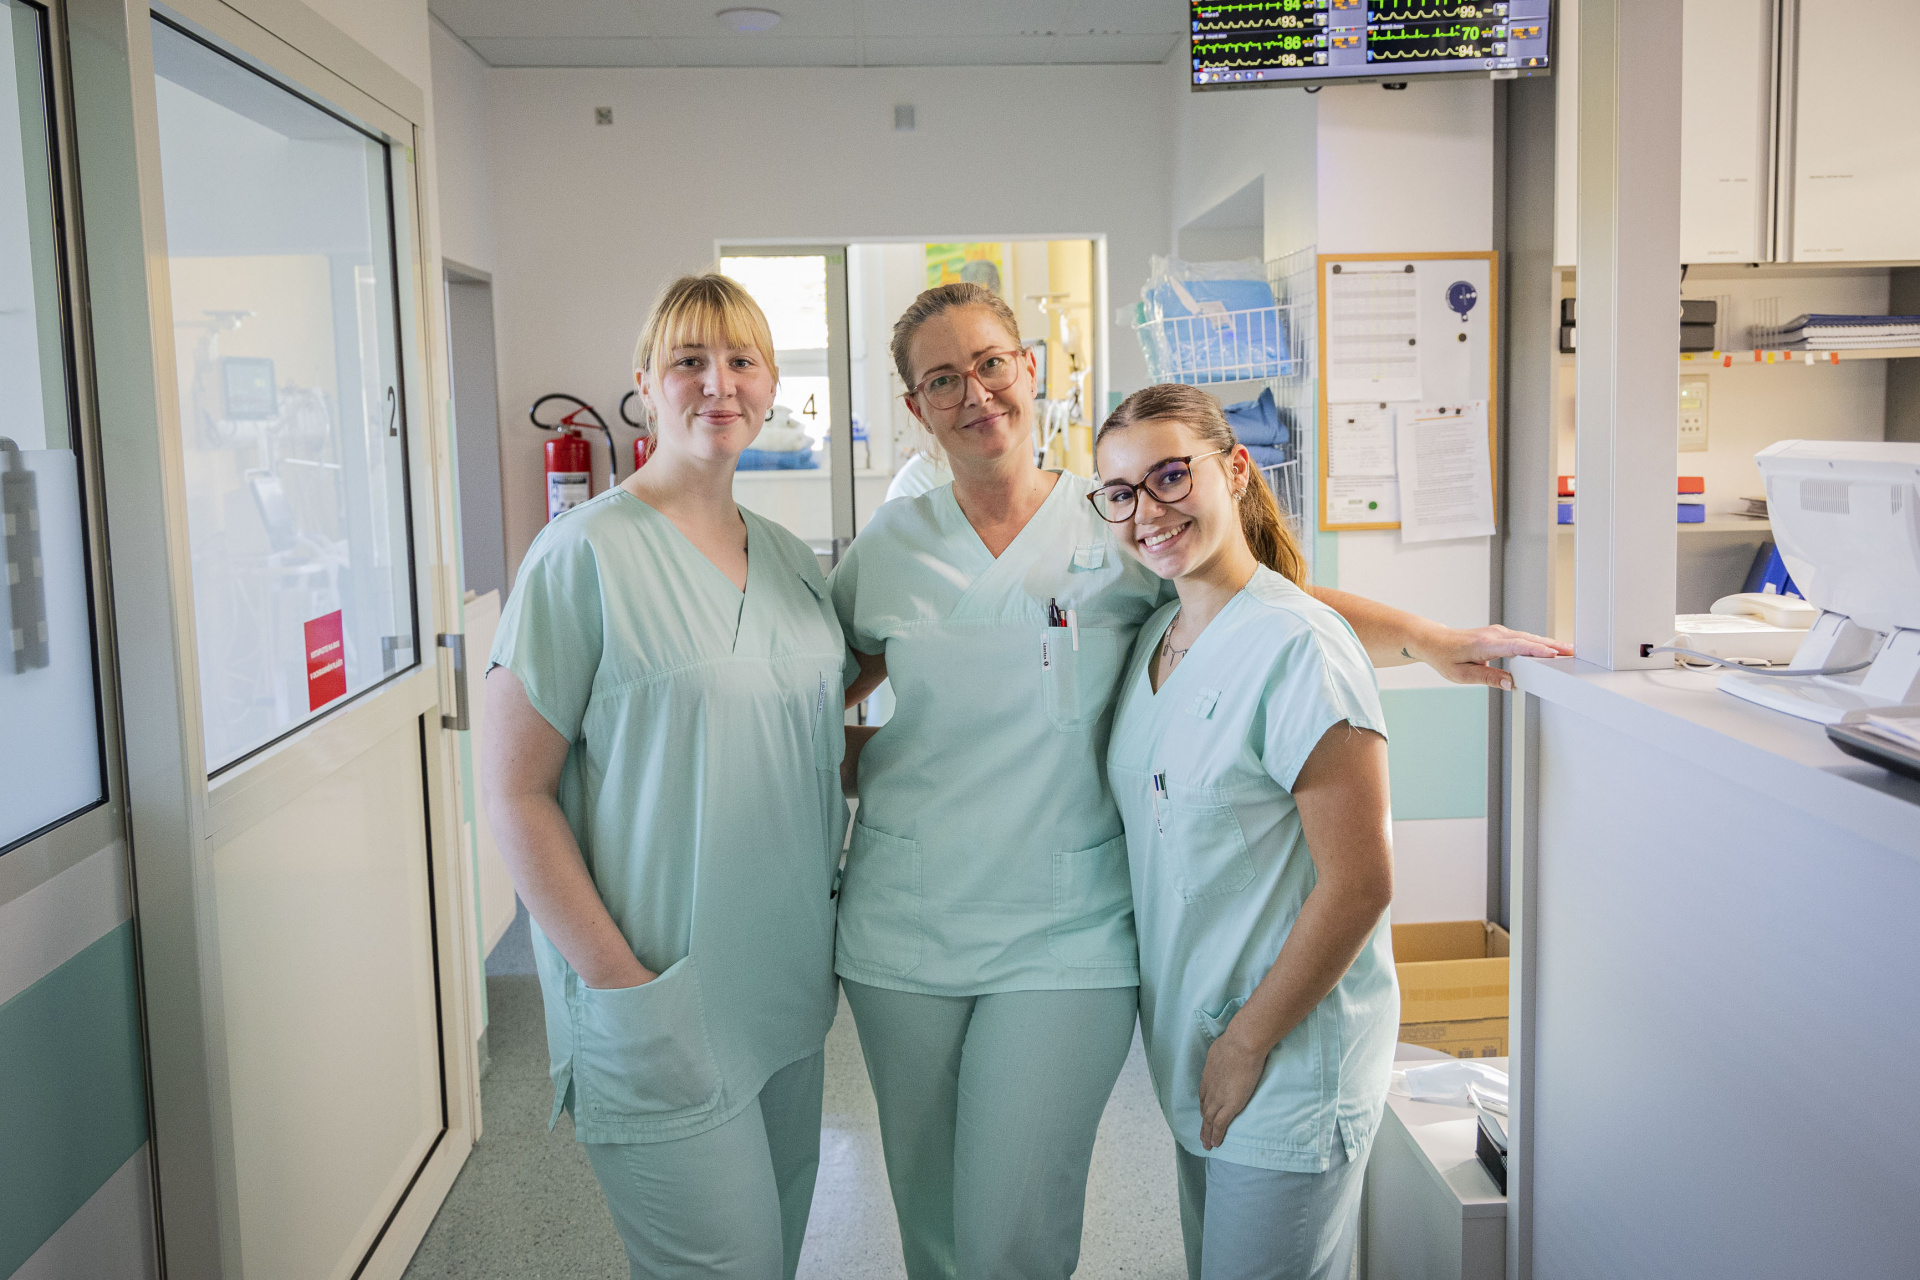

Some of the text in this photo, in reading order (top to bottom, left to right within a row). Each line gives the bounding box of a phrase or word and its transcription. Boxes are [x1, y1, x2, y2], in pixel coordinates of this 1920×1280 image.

[1284, 35, 1302, 50] 86
[1461, 26, 1480, 40] 70
[387, 385, 397, 437] 2
[803, 393, 818, 420] 4
